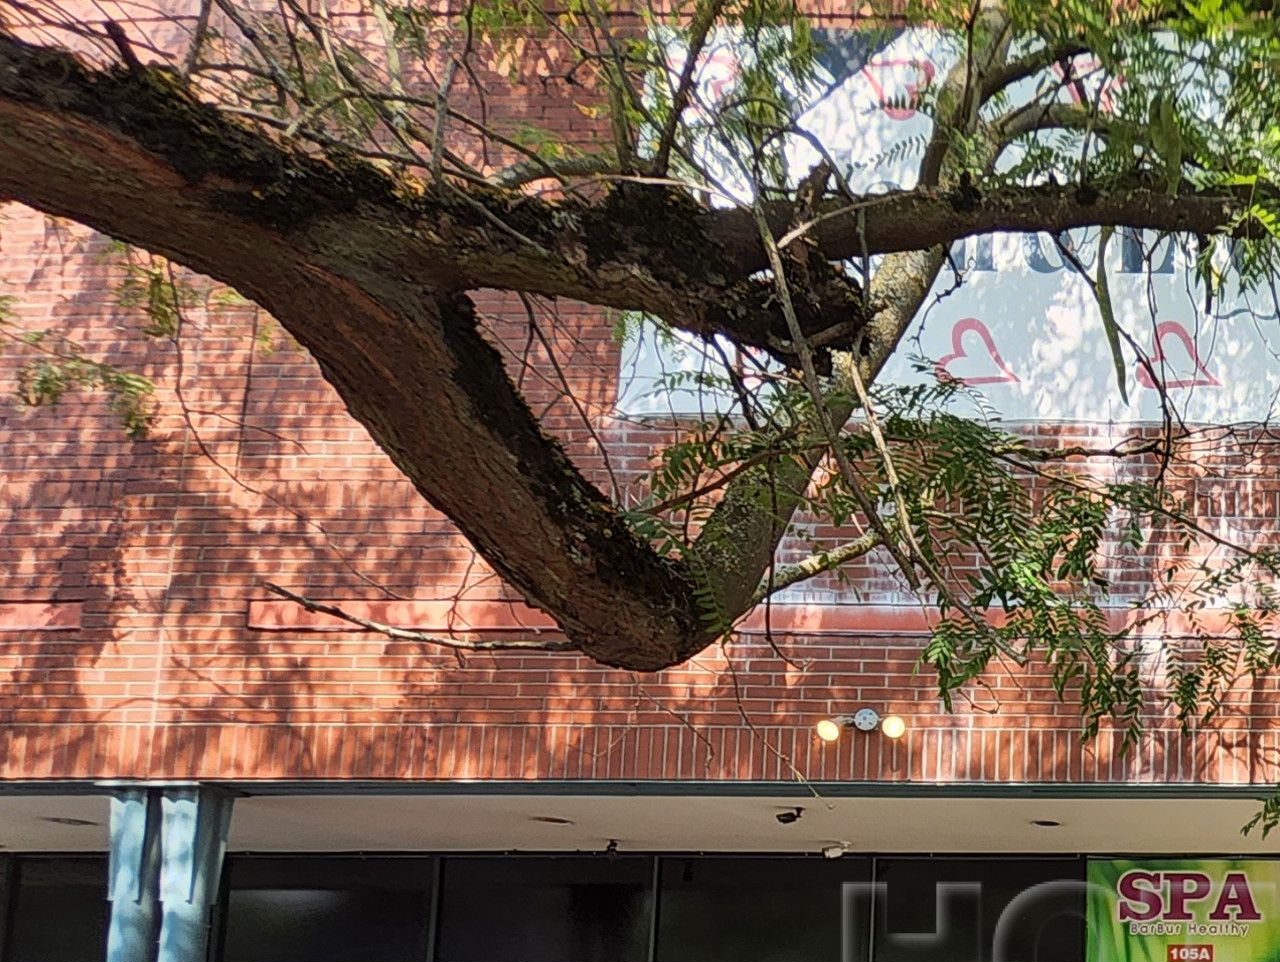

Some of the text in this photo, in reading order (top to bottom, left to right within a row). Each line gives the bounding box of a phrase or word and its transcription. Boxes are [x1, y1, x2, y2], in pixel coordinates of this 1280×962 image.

[1117, 869, 1264, 922] SPA
[1188, 923, 1249, 936] Healthy
[1170, 947, 1211, 960] 105A
